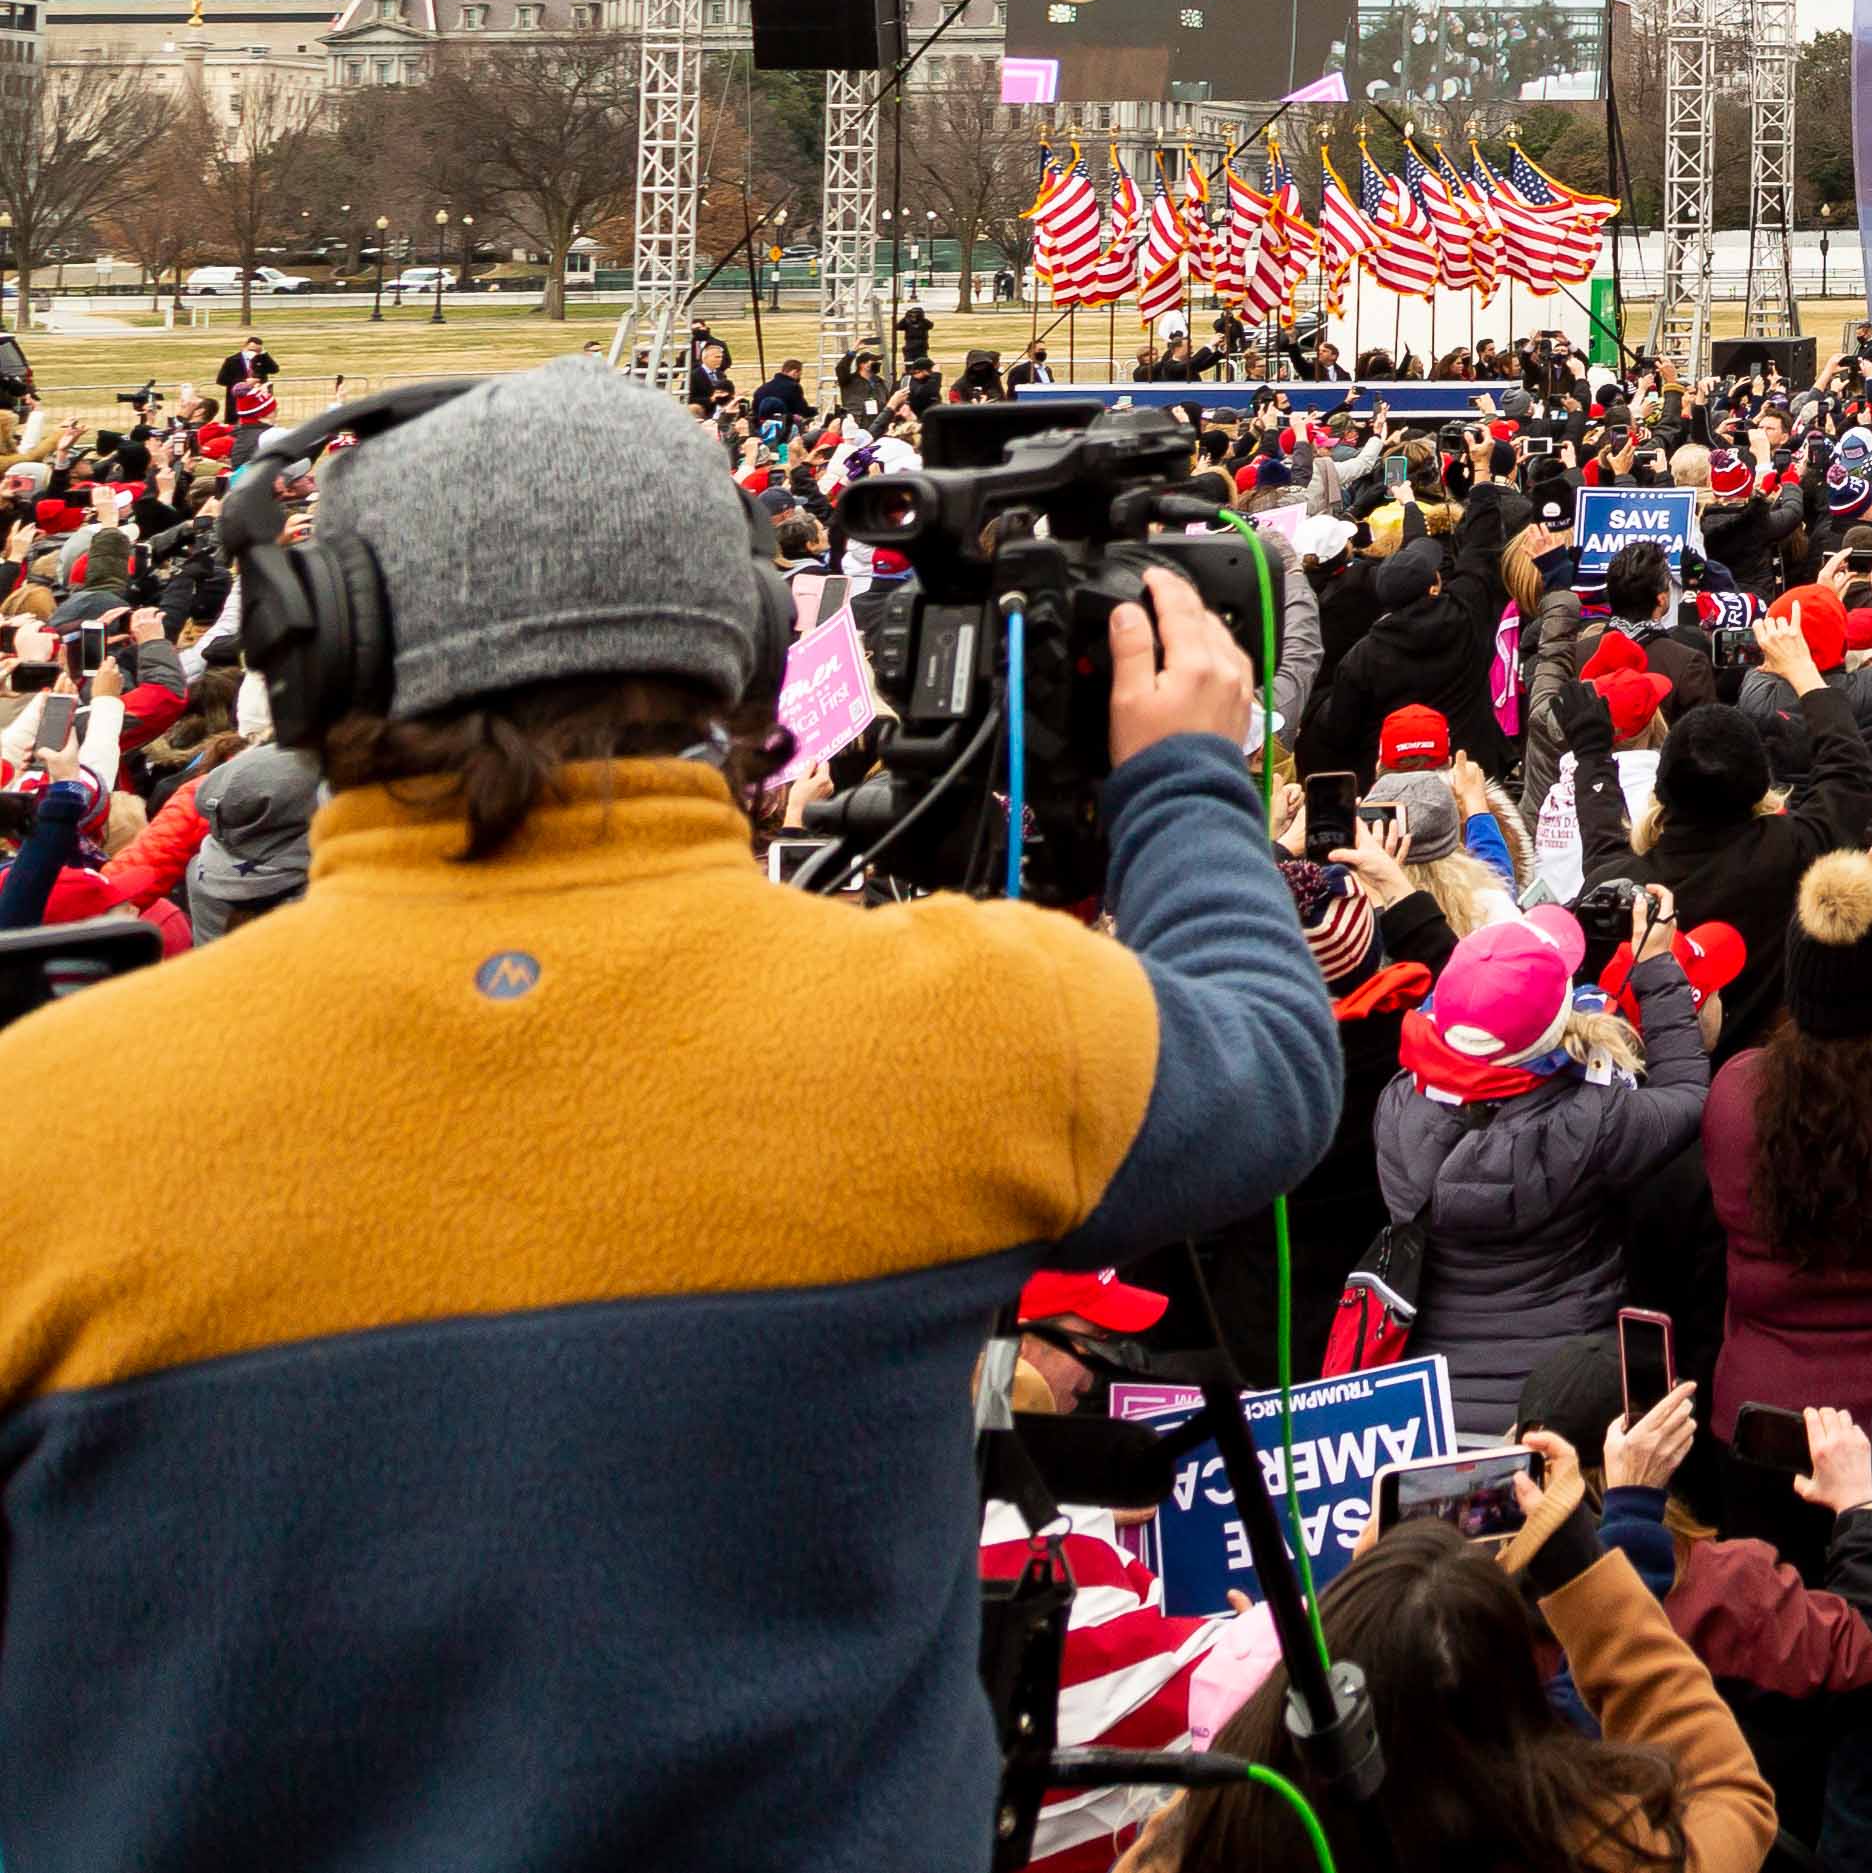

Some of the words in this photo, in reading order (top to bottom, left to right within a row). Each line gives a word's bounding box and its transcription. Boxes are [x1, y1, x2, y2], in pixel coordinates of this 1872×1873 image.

[1609, 509, 1671, 530] SAVE
[779, 656, 840, 702] omen
[1174, 1417, 1421, 1512] AMERCA
[1223, 1497, 1370, 1570] SAE
